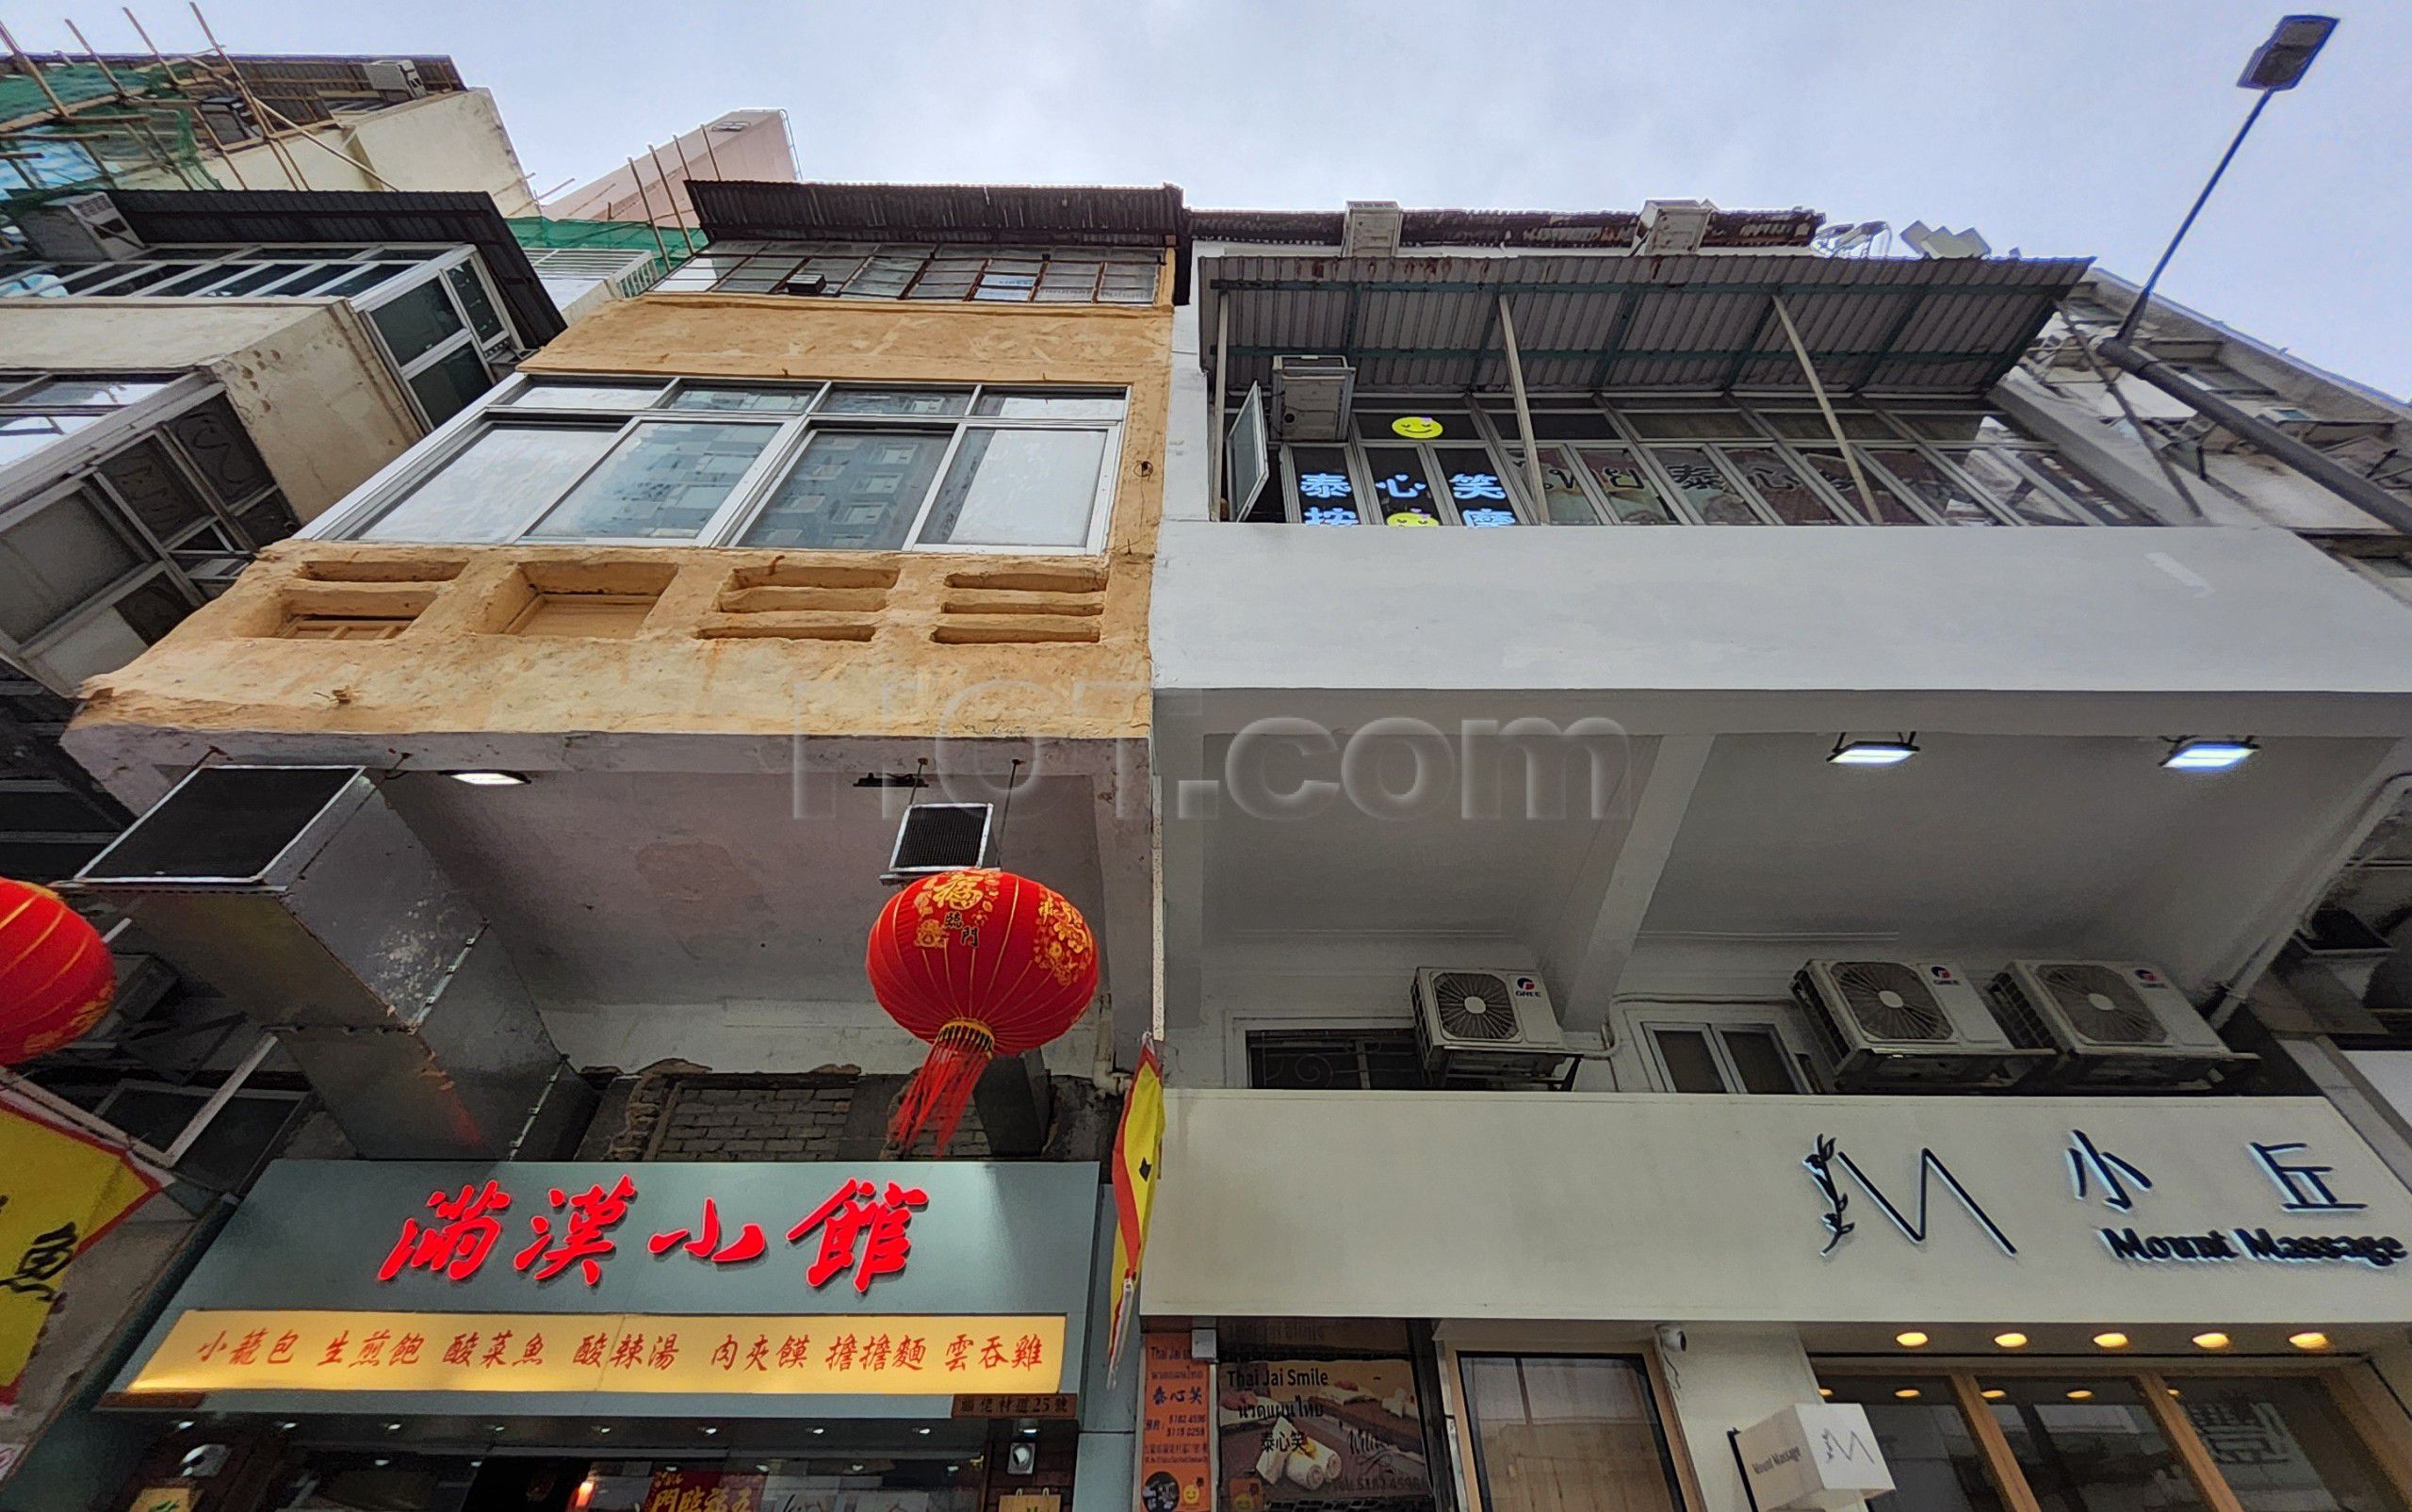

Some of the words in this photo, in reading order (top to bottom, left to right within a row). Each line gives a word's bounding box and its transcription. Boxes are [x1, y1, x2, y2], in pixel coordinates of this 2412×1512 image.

[1299, 472, 1507, 500] 泰心笑
[2097, 1227, 2239, 1262] Mount
[2228, 1227, 2408, 1269] Massage
[442, 1330, 545, 1369] 酸菜魚
[572, 1333, 679, 1371] 酸辣湯
[1227, 1369, 1260, 1387] Thai
[1263, 1369, 1283, 1387] Jai
[1287, 1368, 1328, 1387] Smile
[1262, 1430, 1306, 1453] 泰心笑
